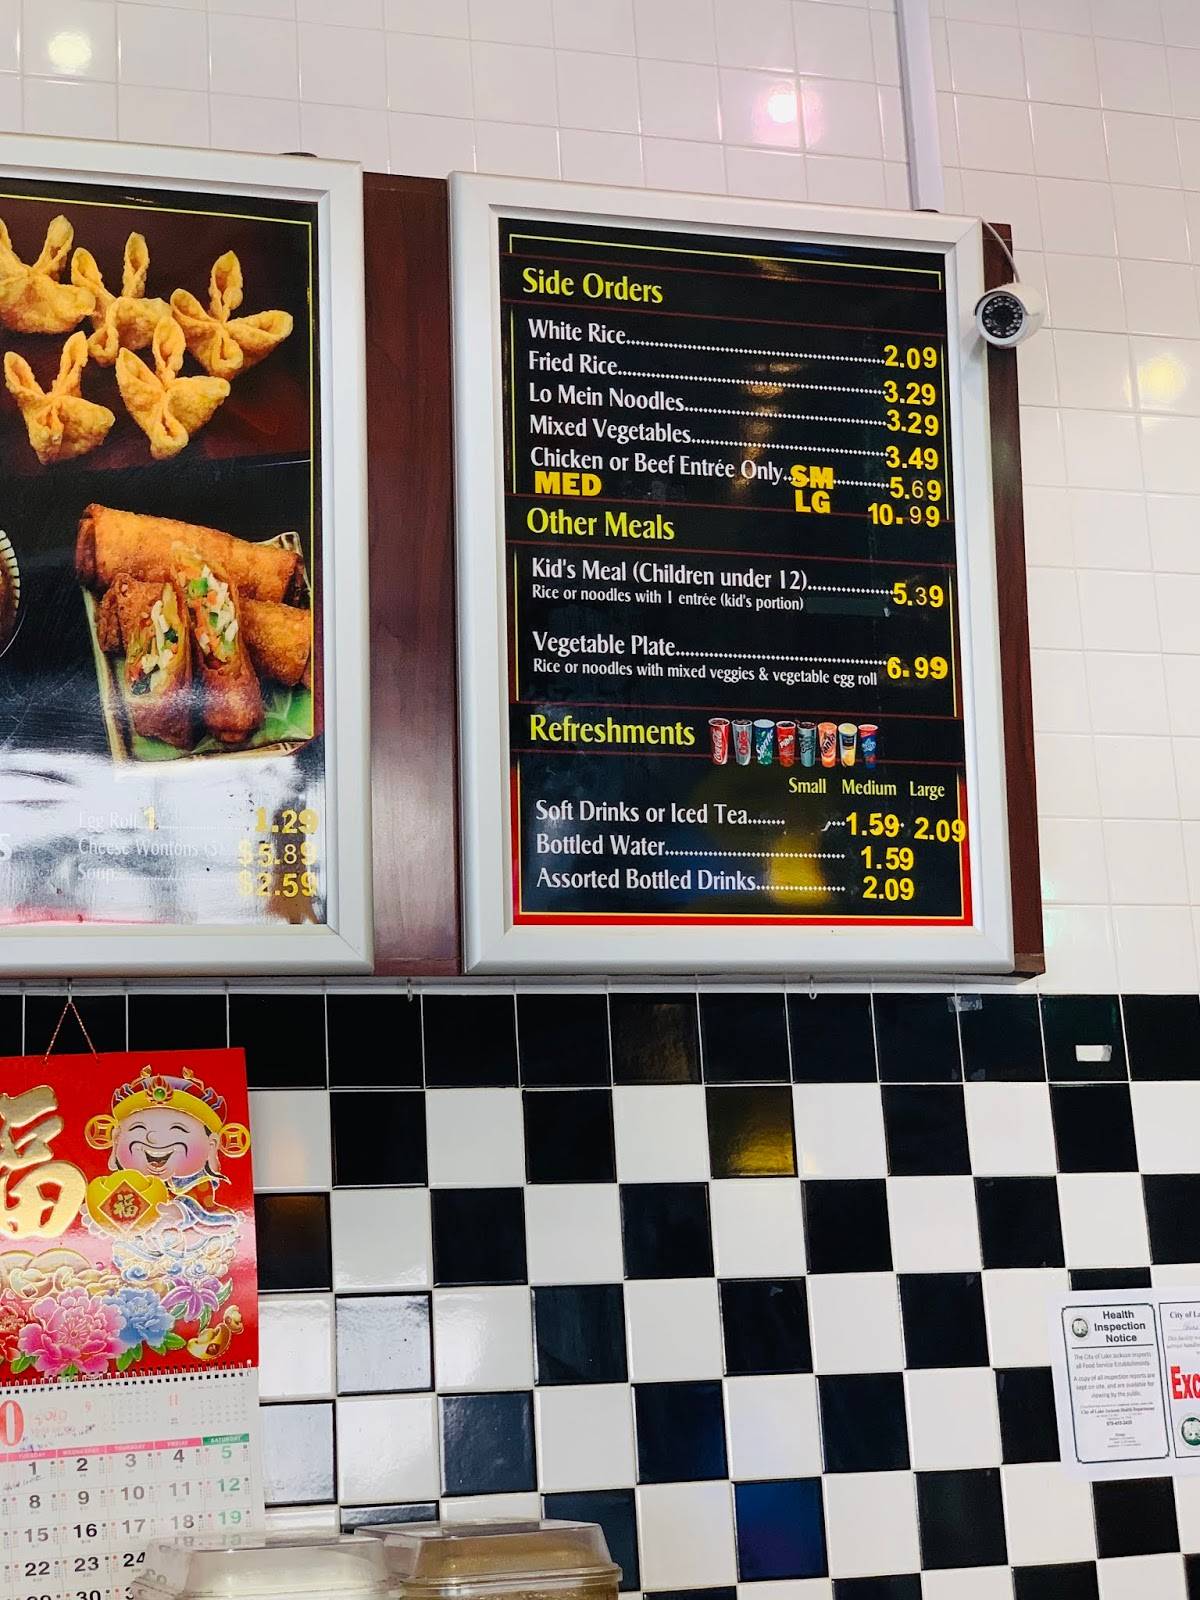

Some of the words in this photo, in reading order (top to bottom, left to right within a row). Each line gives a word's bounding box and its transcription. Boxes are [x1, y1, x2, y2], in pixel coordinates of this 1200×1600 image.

[523, 267, 575, 296] Side
[583, 273, 663, 303] Orders
[528, 318, 582, 341] White
[588, 323, 626, 344] Rice
[884, 345, 937, 370] 2.09
[529, 350, 574, 373] Fried
[580, 354, 618, 375] Rice
[884, 380, 936, 406] 3.29
[529, 382, 552, 403] Lo
[558, 384, 603, 407] Mein
[609, 388, 685, 412] Noodles
[887, 409, 939, 436] 3.29
[530, 415, 587, 437] Mixed
[592, 418, 692, 444] Vegetables
[886, 445, 939, 471] 3.49
[531, 447, 603, 470] Chicken
[609, 456, 630, 471] or
[634, 453, 676, 474] Beef
[680, 455, 735, 478] Entrée
[741, 460, 784, 485] Only
[790, 465, 834, 489] SM
[890, 477, 942, 501] 5.69
[534, 471, 602, 496] MED
[795, 490, 831, 514] LG
[868, 503, 940, 527] 10.99
[527, 507, 598, 536] Other
[605, 511, 676, 540] Meals
[532, 557, 576, 579] Kid's
[582, 560, 626, 581] Meal
[633, 561, 715, 586] (Children
[720, 568, 772, 588] under
[780, 569, 808, 591] 12)
[893, 582, 944, 608] 5.39
[532, 584, 560, 600] Rice
[563, 590, 578, 600] or
[581, 588, 632, 603] noodles
[635, 589, 662, 604] with
[678, 593, 717, 607] entrée
[720, 593, 752, 608] (kid's
[756, 596, 804, 611] portion)
[532, 631, 625, 658] Vegetable
[631, 635, 676, 657] Plate
[887, 656, 949, 680] 6.99
[533, 658, 560, 673] Rice
[564, 663, 579, 674] or
[582, 661, 633, 676] noodles
[637, 663, 664, 677] with
[668, 665, 707, 679] mixed
[709, 666, 755, 683] veggies
[758, 667, 769, 681] &
[773, 669, 830, 685] vegetable
[833, 673, 856, 688] egg
[858, 672, 878, 686] roll
[530, 714, 696, 746] Refreshments
[788, 777, 827, 794] Small
[842, 779, 897, 796] Medium
[909, 781, 945, 801] Large
[110, 812, 137, 829] Roll
[255, 807, 319, 834] 1.29
[536, 799, 574, 822] Soft
[579, 800, 640, 823] Drinks
[646, 805, 666, 823] or
[671, 803, 708, 824] Iced
[713, 803, 748, 825] Tea
[846, 812, 899, 838] 1.59
[914, 817, 966, 842] 2.09
[78, 838, 129, 856] Cheese
[136, 839, 198, 856] Wontons
[536, 833, 604, 855] Bottled
[610, 834, 665, 856] Water
[860, 845, 915, 871] 1.59
[536, 867, 620, 889] Assorted
[626, 868, 692, 890] Bottled
[698, 870, 757, 891] Drinks
[862, 875, 915, 901] 2.09
[1094, 1322, 1146, 1333] Inspection
[1102, 1310, 1135, 1320] Health
[1105, 1334, 1138, 1343] Notice
[28, 1461, 37, 1475] 1
[76, 1458, 88, 1472] 2
[125, 1453, 136, 1468] 3
[173, 1449, 185, 1463] 4
[221, 1445, 232, 1459] 5
[29, 1495, 41, 1509] 8
[78, 1491, 90, 1505] 9
[121, 1485, 145, 1500] 10
[169, 1481, 190, 1496] 11
[218, 1478, 241, 1492] 12
[24, 1528, 49, 1543] 15
[73, 1523, 98, 1538] 16
[122, 1519, 146, 1534] 17
[171, 1514, 194, 1530] 18
[218, 1510, 241, 1525] 19
[25, 1561, 50, 1577] 22
[74, 1556, 99, 1572] 23
